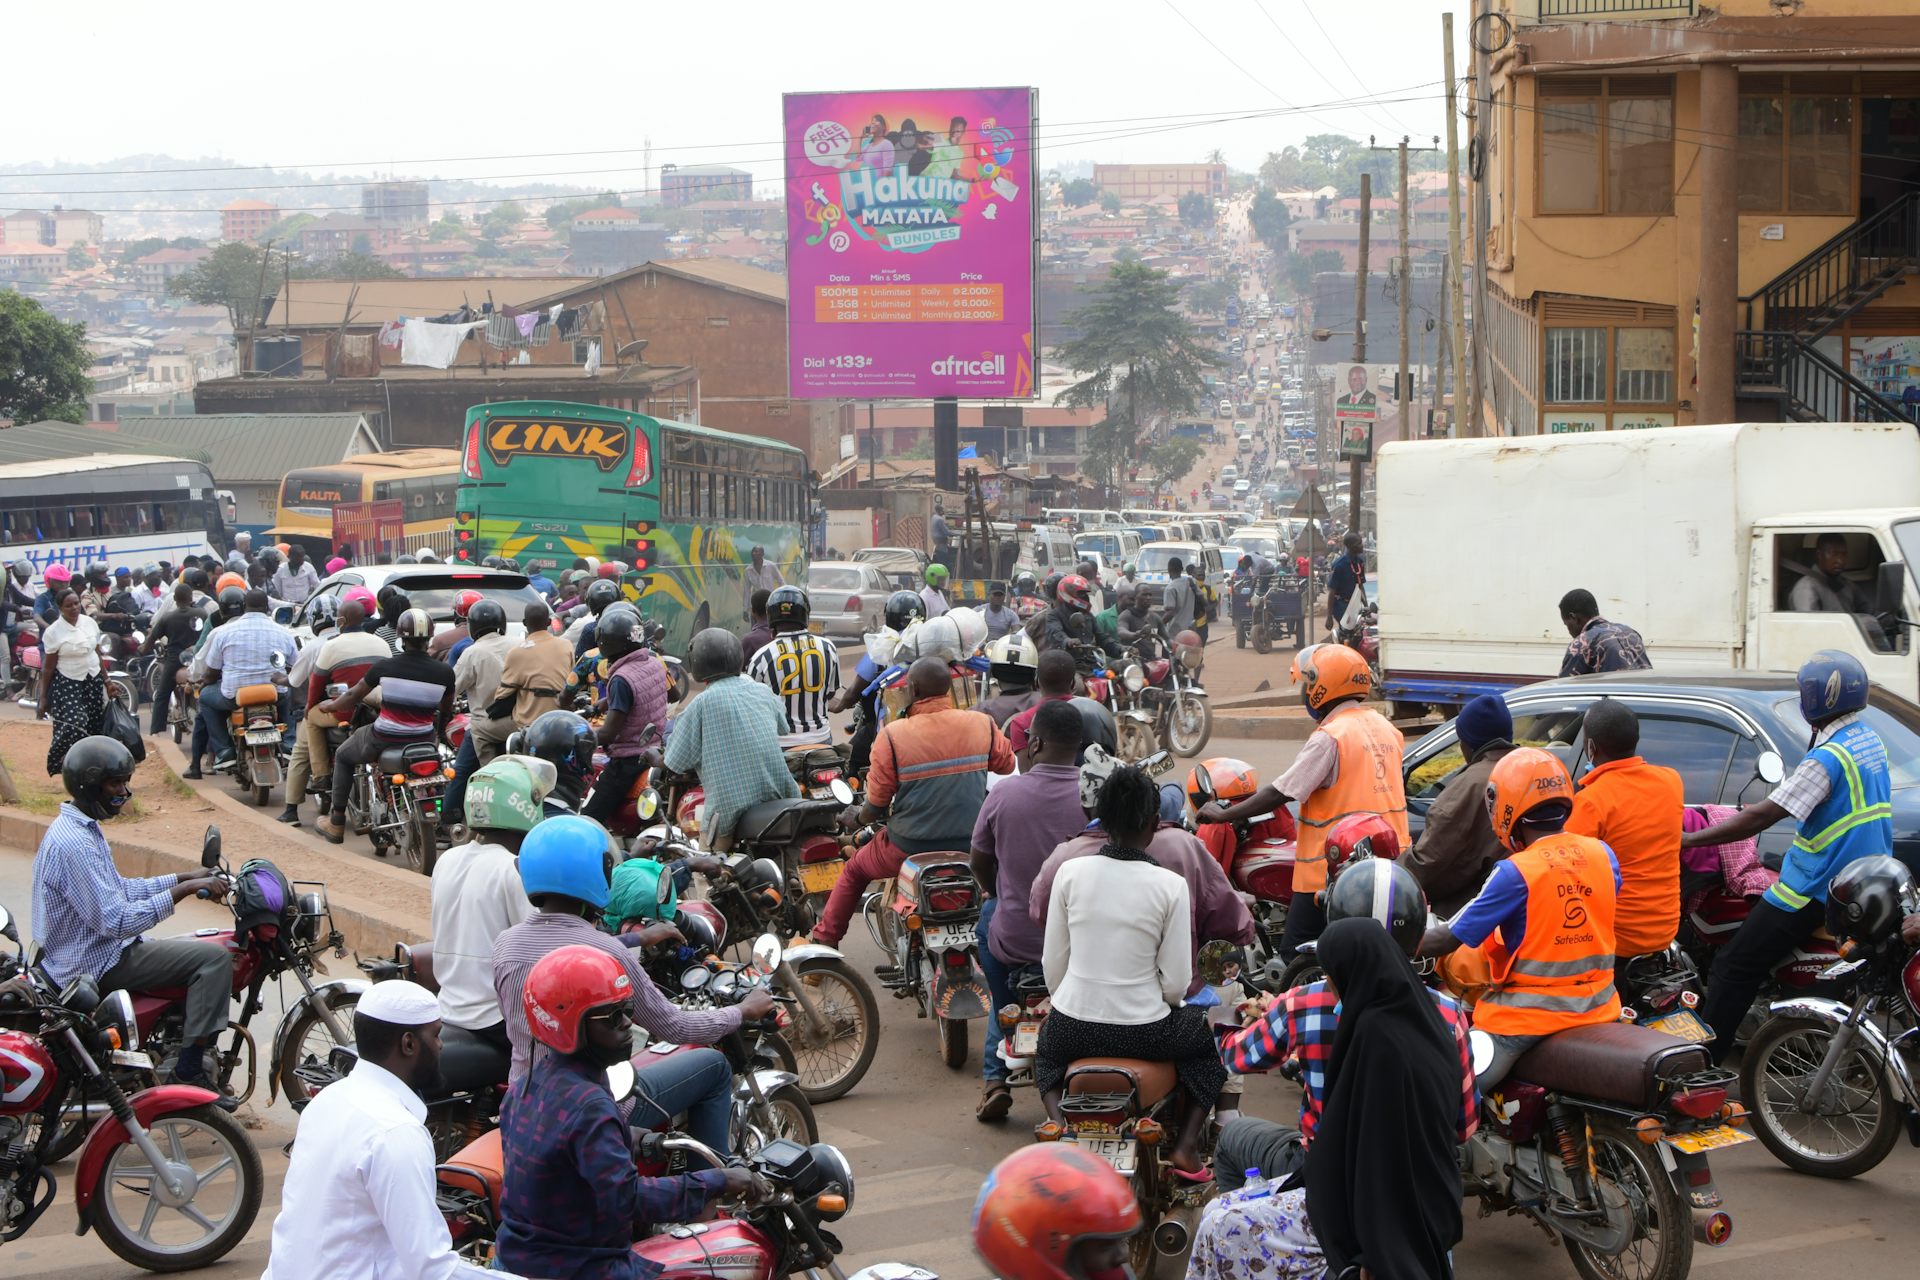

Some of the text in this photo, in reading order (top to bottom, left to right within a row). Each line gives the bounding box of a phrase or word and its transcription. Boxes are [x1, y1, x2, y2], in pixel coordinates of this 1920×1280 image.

[809, 123, 842, 144] FREE
[816, 131, 849, 154] OTT
[840, 165, 969, 211] Hakuna
[862, 208, 948, 225] MATATA
[893, 228, 957, 246] BUNDLES
[829, 274, 851, 282] Data
[892, 273, 911, 281] SMS
[960, 272, 983, 280] Price
[821, 288, 859, 297] 500MB
[921, 288, 941, 296] Daily
[837, 312, 912, 321] 2GB Unlimited
[921, 311, 953, 319] Monthly
[803, 358, 825, 368] Dial
[930, 354, 1005, 376] africell
[490, 423, 625, 458] LINK
[300, 489, 342, 501] KALITA
[531, 523, 569, 532] ISUZU
[25, 544, 108, 575] KALITA
[775, 649, 825, 696] 20
[1310, 684, 1328, 707] 4853
[466, 785, 495, 803] Bolt
[507, 791, 539, 823] 5631
[1553, 932, 1595, 946] SafeBoda
[1089, 1141, 1129, 1154] UEP
[704, 1254, 762, 1266] BOXER
